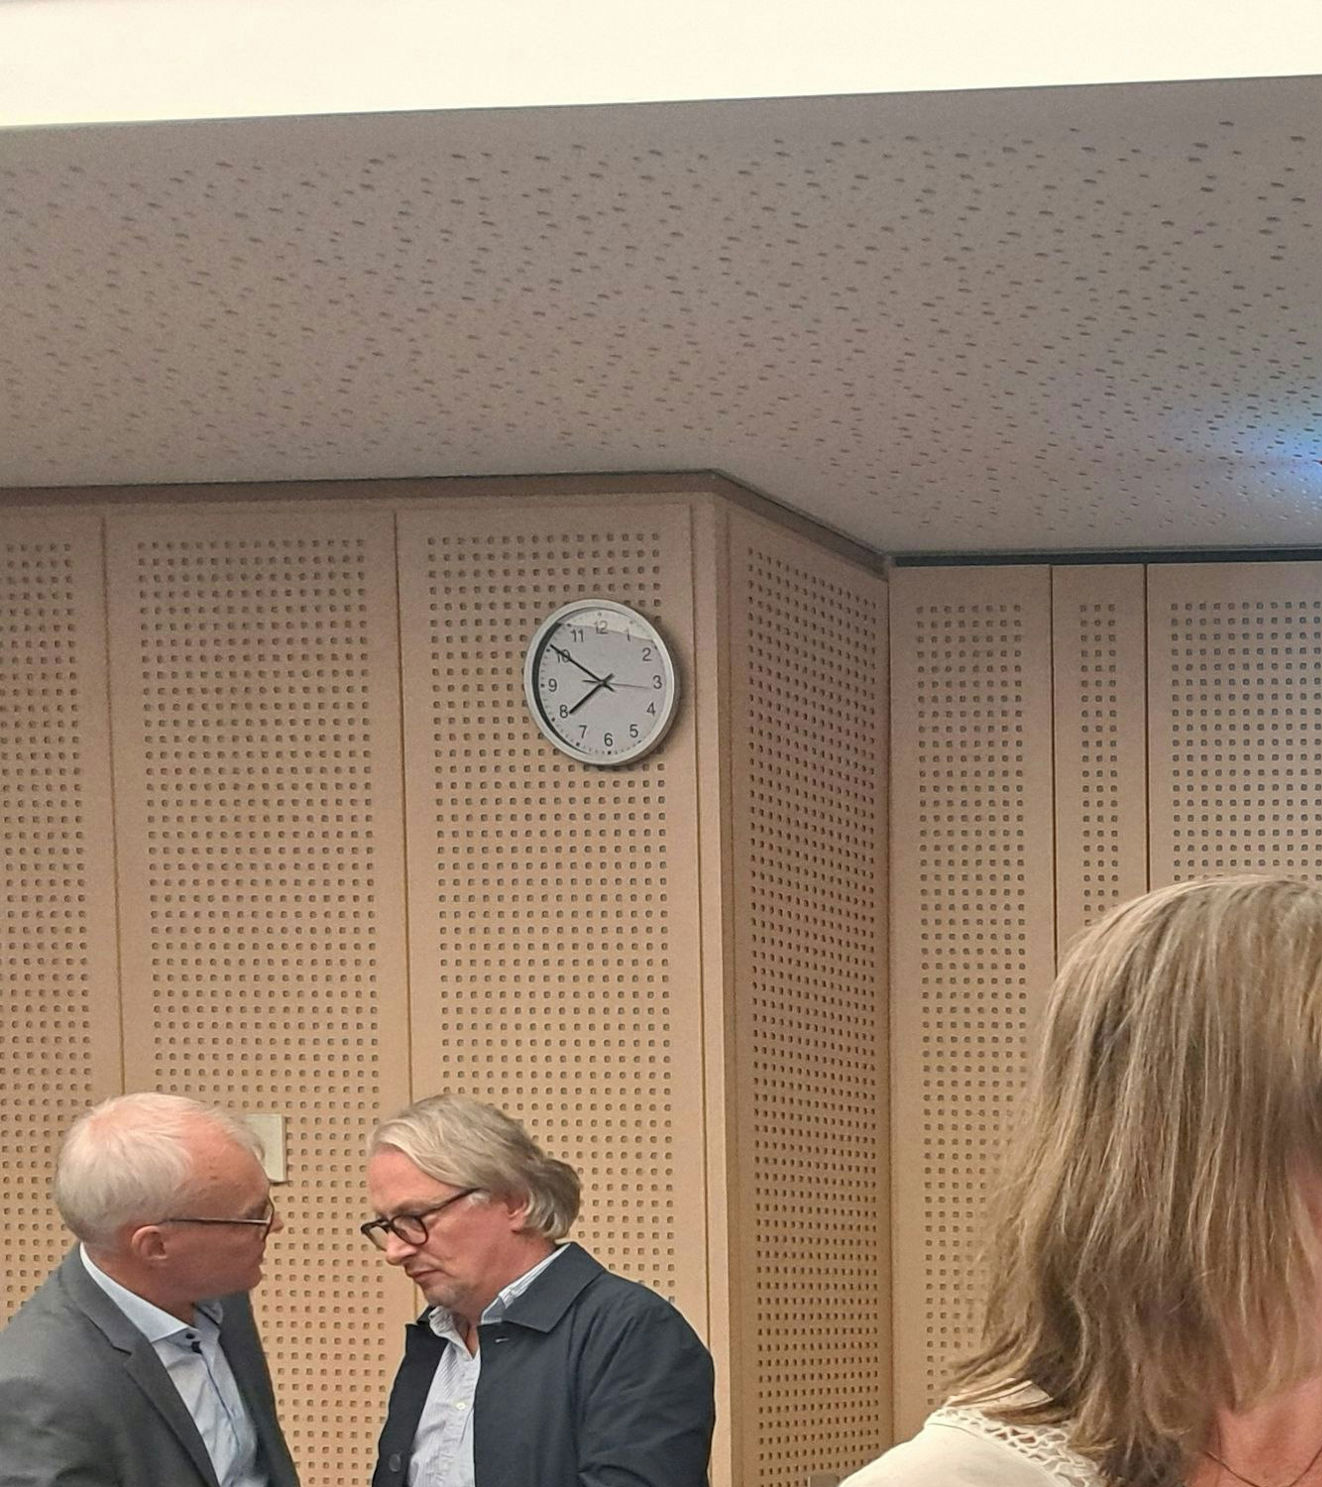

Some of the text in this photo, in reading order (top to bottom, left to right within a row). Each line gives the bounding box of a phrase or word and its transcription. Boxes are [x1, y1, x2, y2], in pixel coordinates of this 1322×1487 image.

[594, 620, 609, 635] 12
[570, 629, 585, 643] 11
[642, 647, 652, 662] 2
[548, 678, 558, 692] 9
[652, 675, 663, 689] 3
[559, 704, 569, 719] 8
[646, 702, 657, 717] 4
[578, 725, 588, 739] 7
[629, 724, 639, 738] 5
[603, 732, 614, 747] 6
